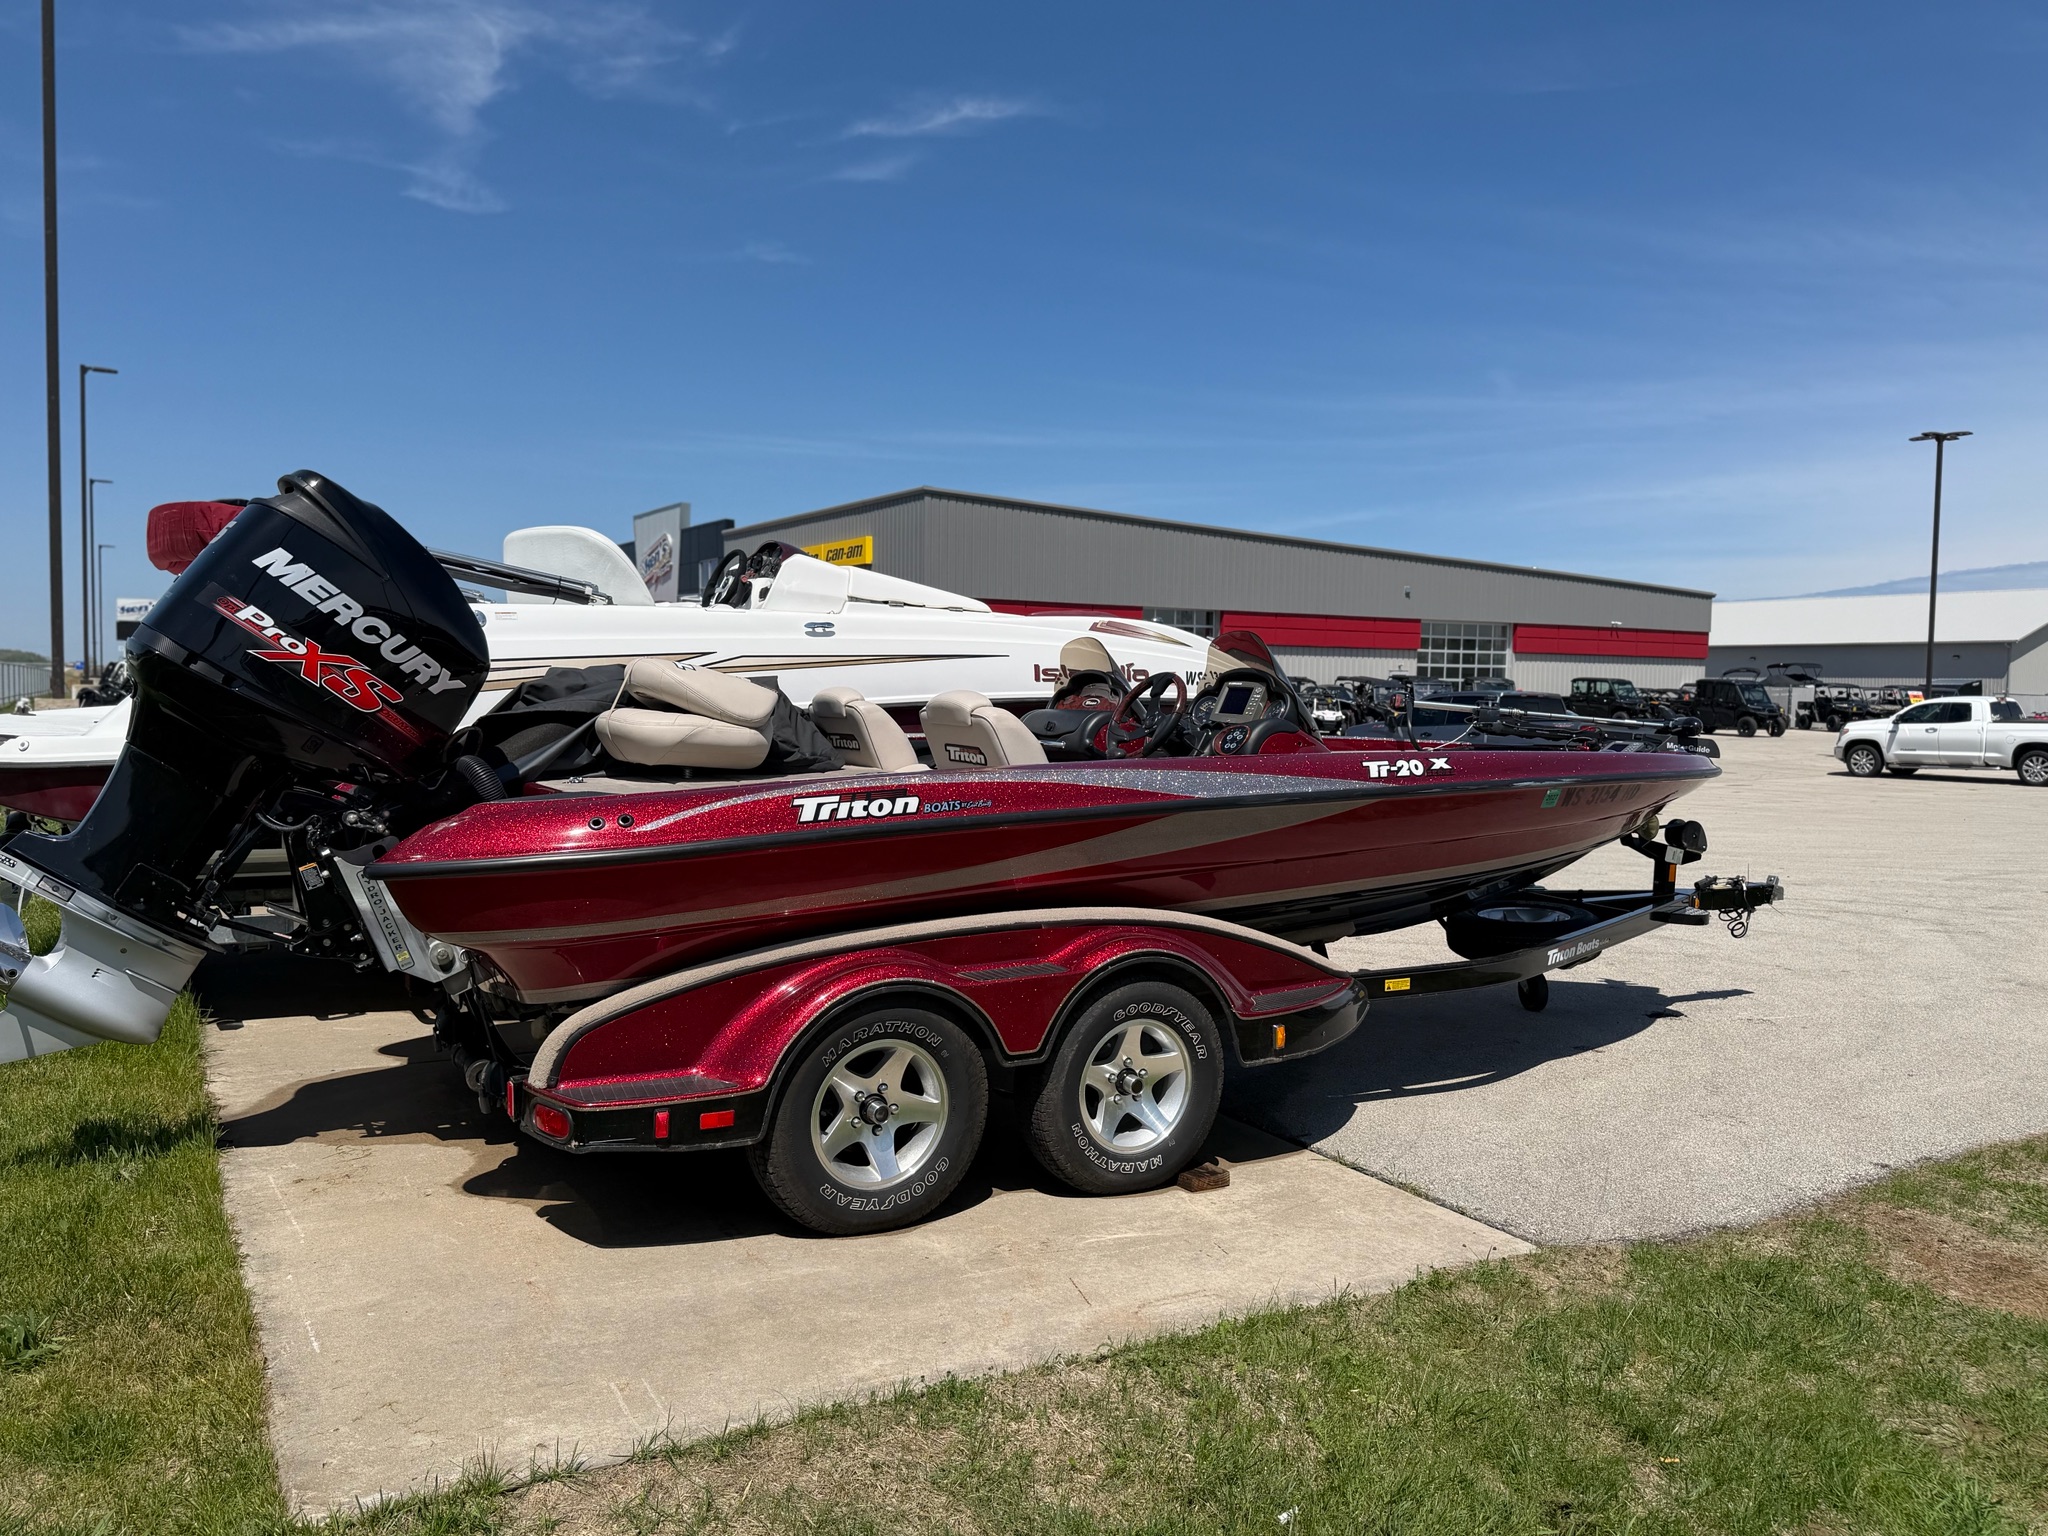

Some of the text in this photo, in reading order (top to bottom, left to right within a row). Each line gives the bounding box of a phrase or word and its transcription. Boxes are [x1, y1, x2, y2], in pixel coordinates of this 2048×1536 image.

[252, 547, 466, 695] MERCURY
[831, 735, 859, 750] Triton
[946, 746, 986, 764] Triton
[1362, 758, 1452, 778] Tr-20 X
[793, 795, 920, 823] Triton
[924, 801, 960, 813] BOATS
[1561, 788, 1585, 807] WS
[1547, 938, 1600, 966] Triton Boats
[823, 1021, 943, 1067] MARATHON
[1113, 1002, 1207, 1059] GOODYEAR
[1072, 1123, 1163, 1173] MARATHON
[820, 1157, 949, 1210] GOODYEAR
